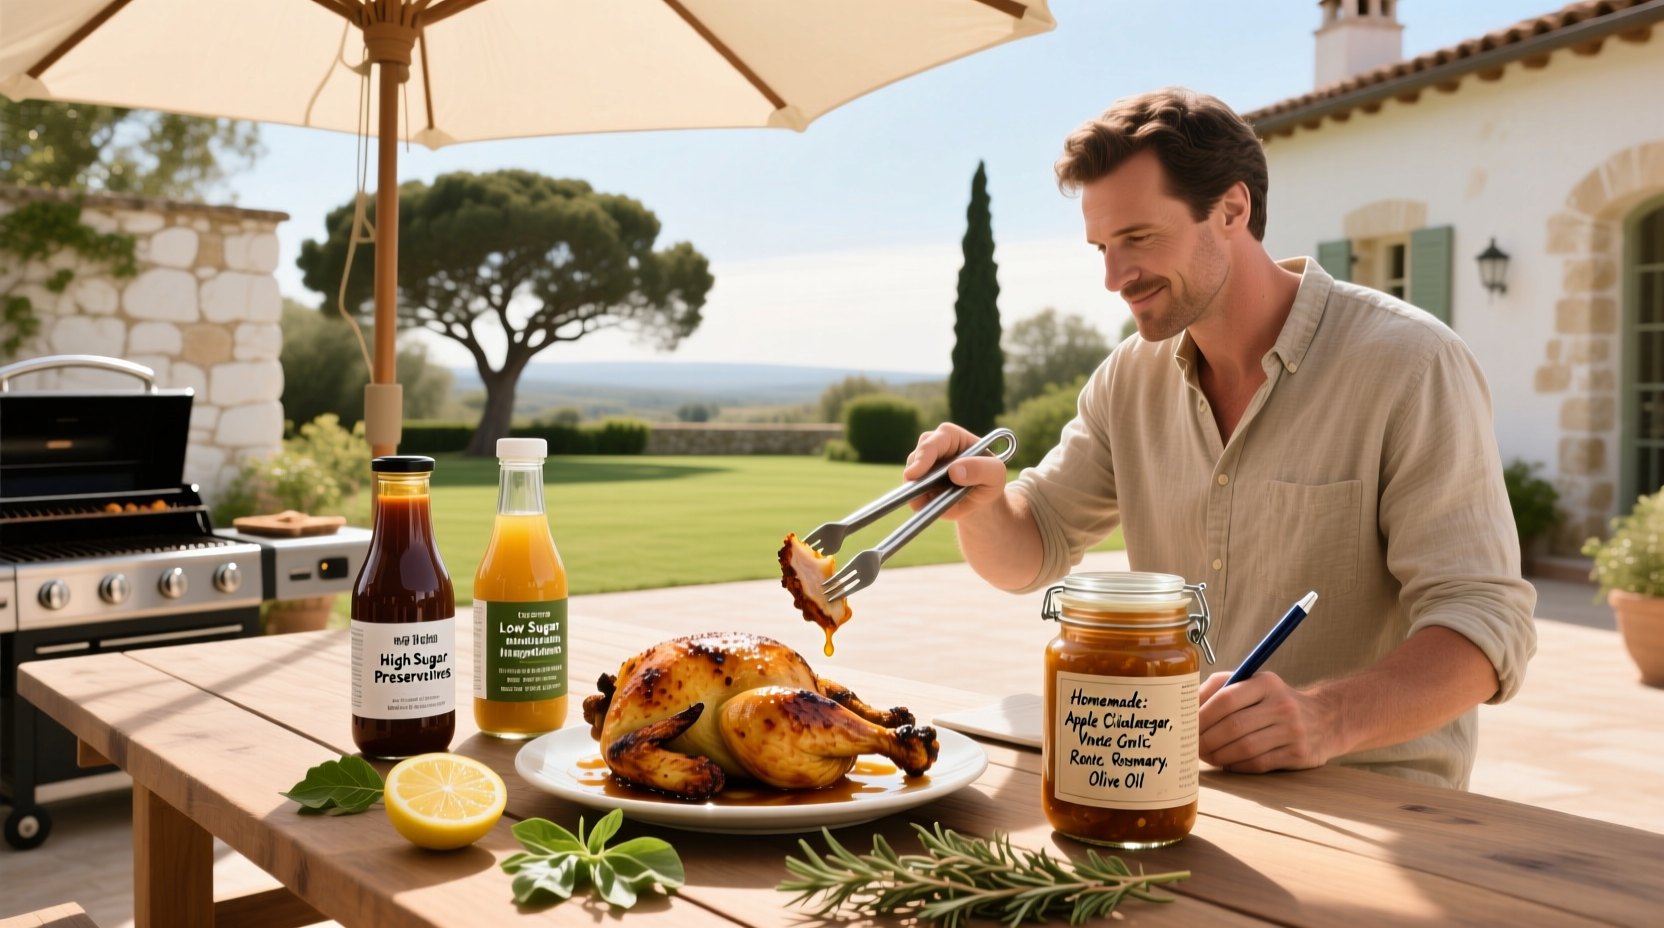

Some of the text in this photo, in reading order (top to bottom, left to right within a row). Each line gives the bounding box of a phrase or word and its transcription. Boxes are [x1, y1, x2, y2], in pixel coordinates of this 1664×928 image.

[499, 621, 525, 634] Low
[380, 652, 448, 671] High Sugar
[1070, 687, 1148, 709] Homemade:
[1064, 710, 1099, 733] Apple
[1088, 770, 1120, 789] Olive
